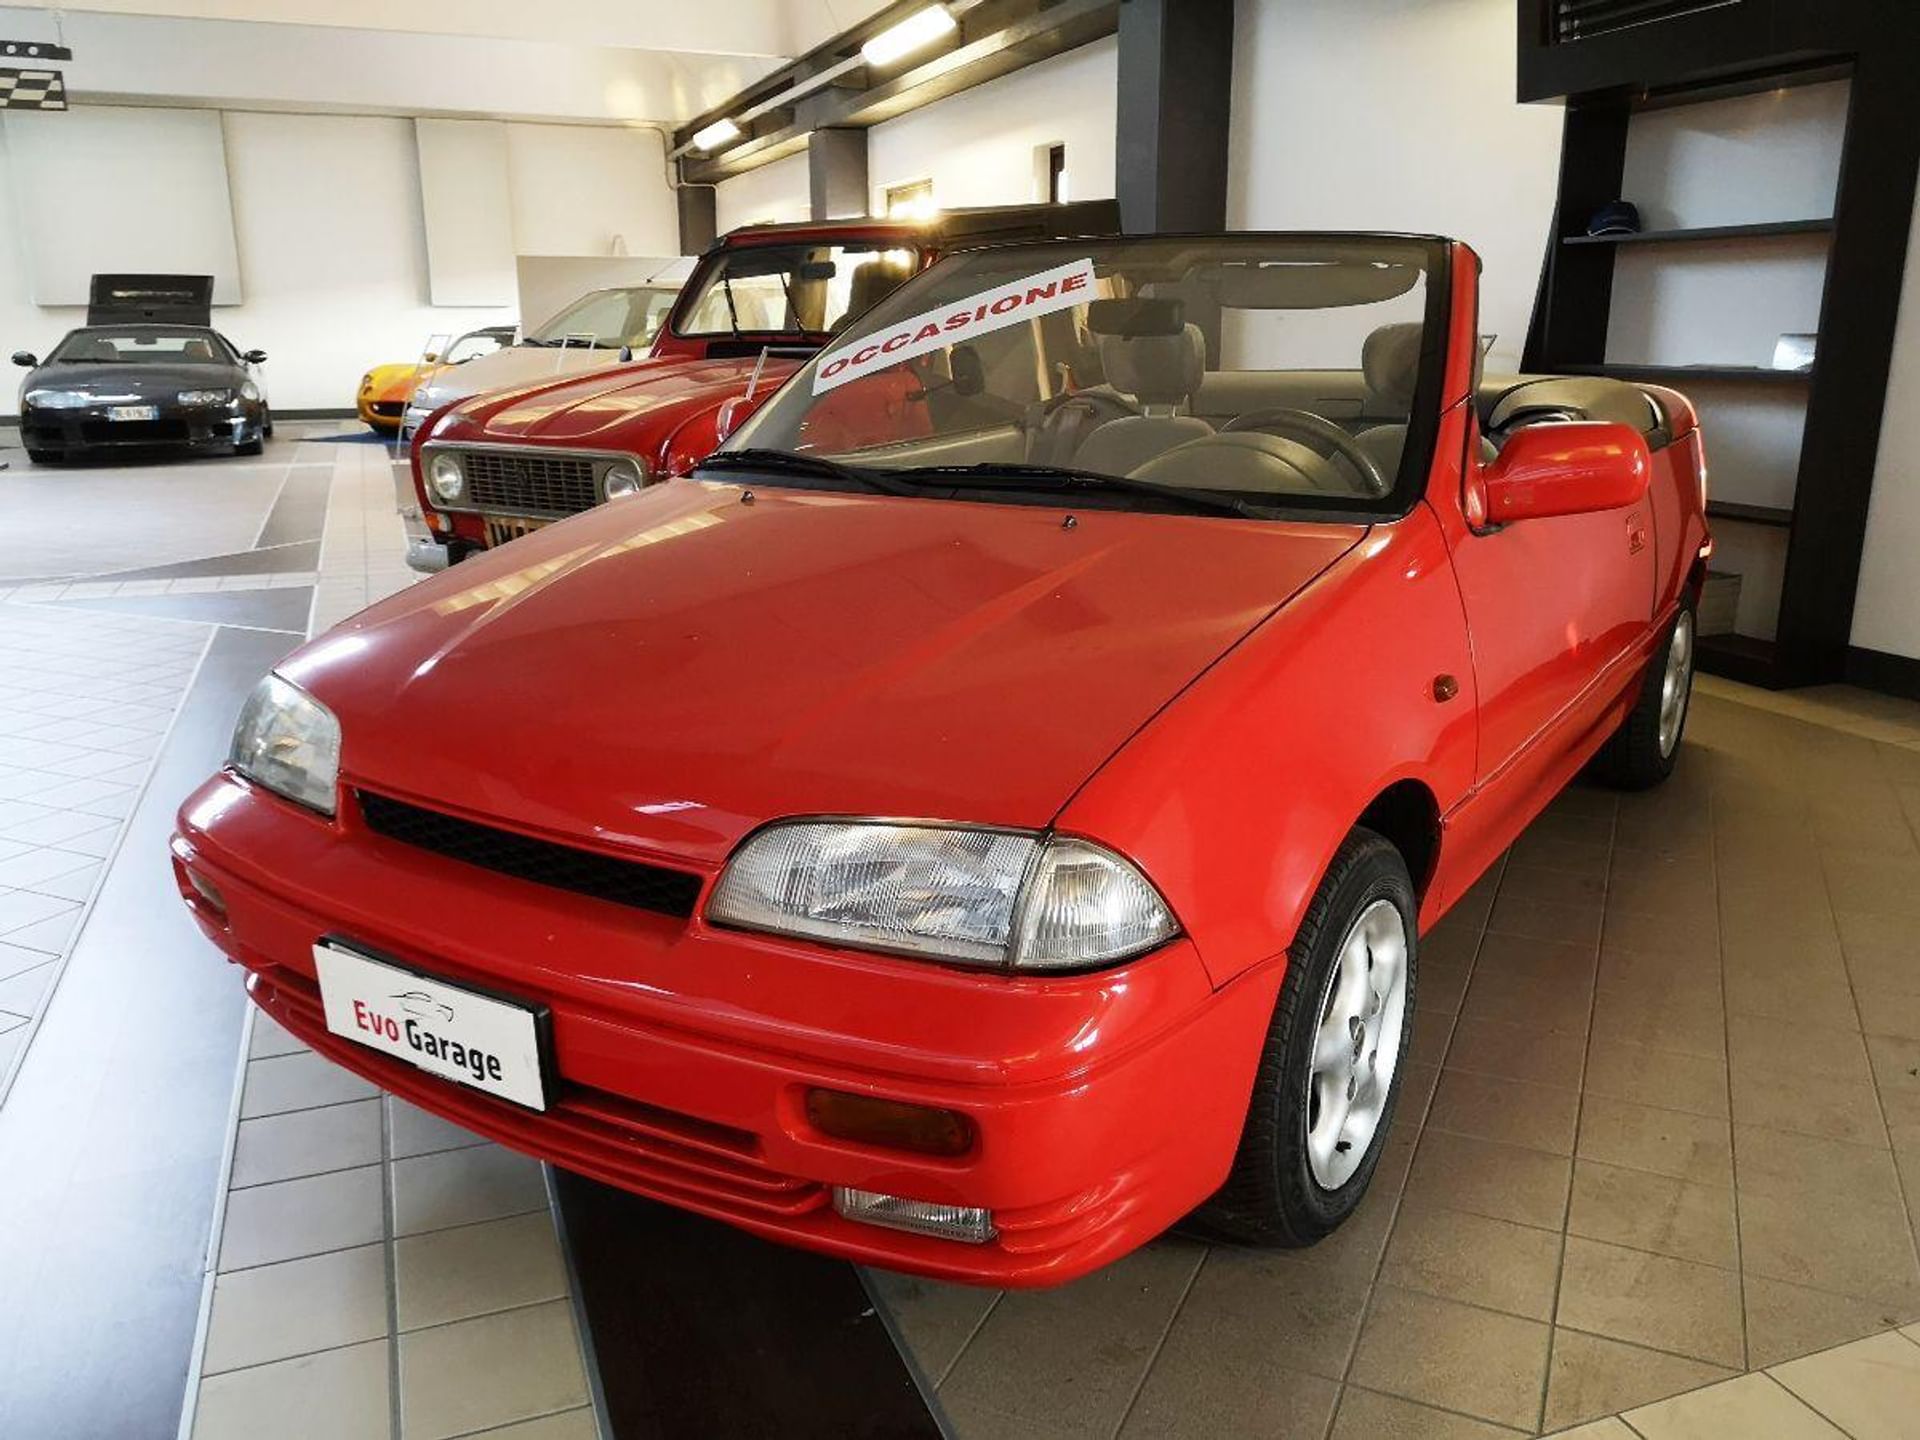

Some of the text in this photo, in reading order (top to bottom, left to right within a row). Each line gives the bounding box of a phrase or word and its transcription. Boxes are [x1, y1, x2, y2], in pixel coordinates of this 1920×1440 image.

[820, 272, 1088, 379] OCCASIONE
[353, 1000, 503, 1081] Evo Garage
